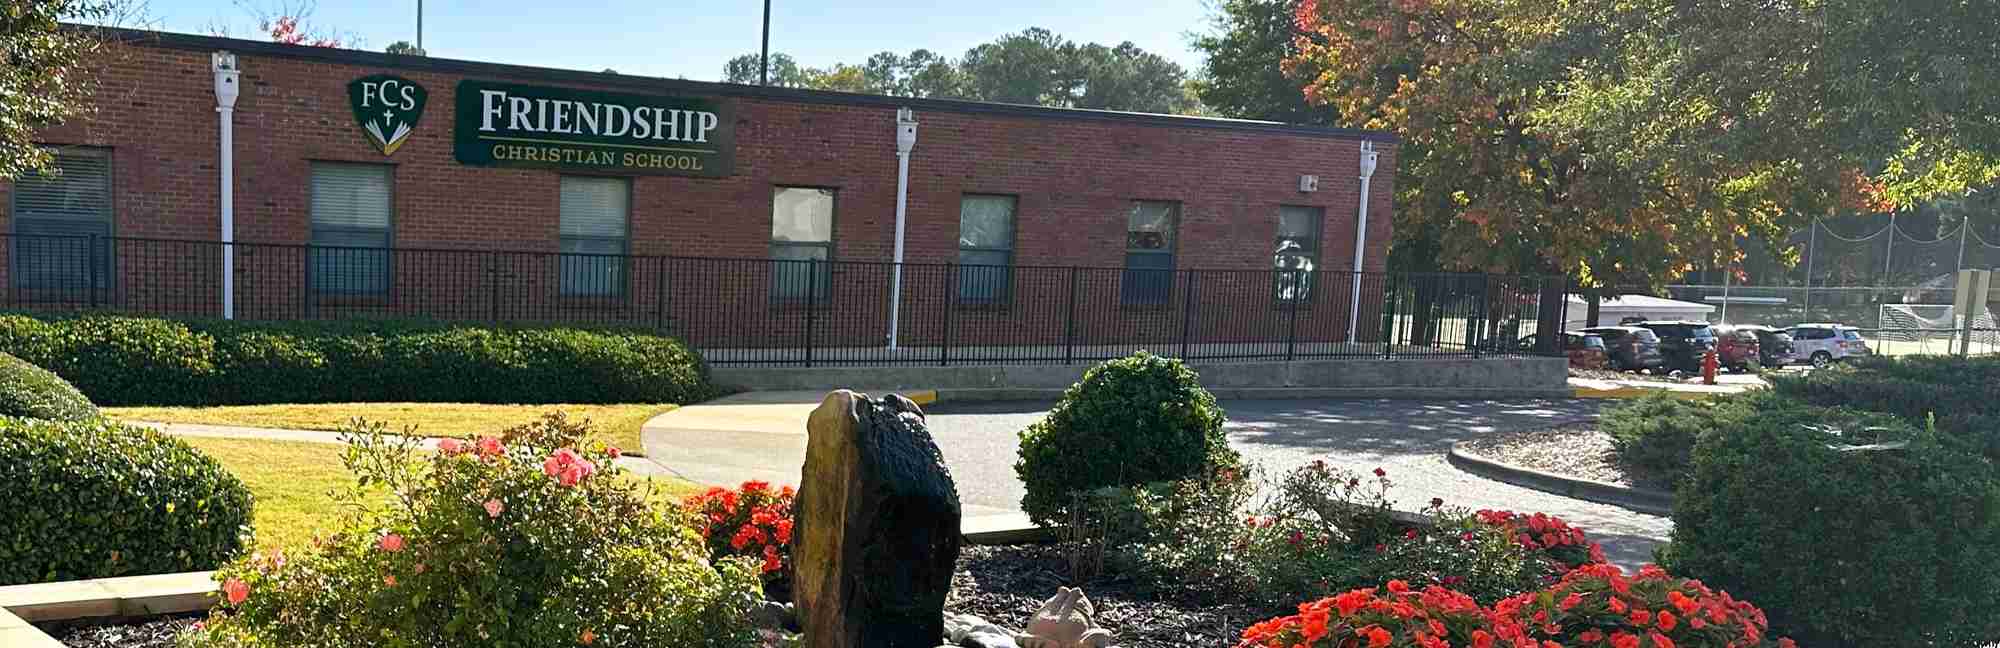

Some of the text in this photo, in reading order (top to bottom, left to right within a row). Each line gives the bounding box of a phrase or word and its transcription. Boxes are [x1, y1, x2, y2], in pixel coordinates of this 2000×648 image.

[362, 79, 416, 110] FCS
[480, 90, 718, 143] FRIENDSHIP
[493, 144, 703, 171] CHRISTIAN SCHOOL
